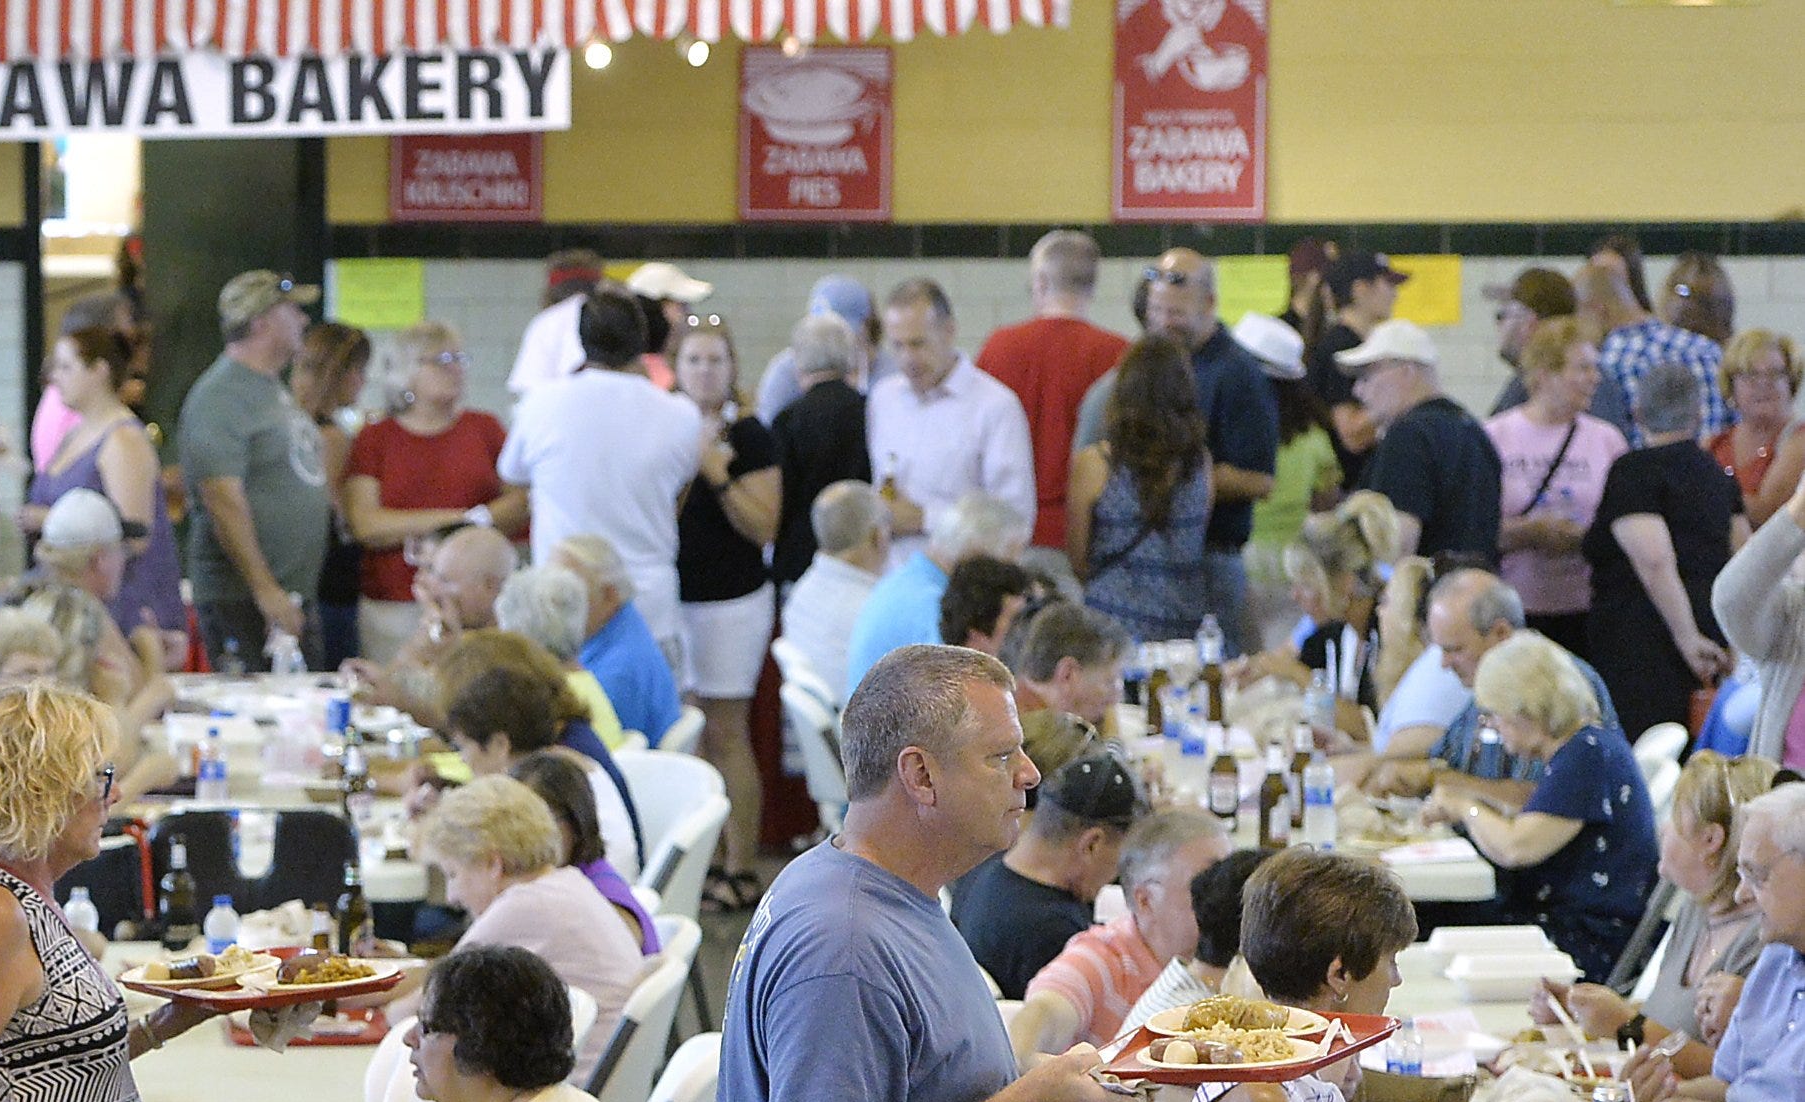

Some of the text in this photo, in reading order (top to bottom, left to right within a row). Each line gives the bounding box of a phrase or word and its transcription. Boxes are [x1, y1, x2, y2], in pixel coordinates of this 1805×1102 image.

[228, 45, 559, 125] BAKERY
[1128, 125, 1250, 160] ZABAWA
[414, 149, 520, 177] ZABAWA
[762, 144, 869, 175] ZABAWA
[788, 176, 842, 207] PIES
[1134, 160, 1244, 194] BAKERY
